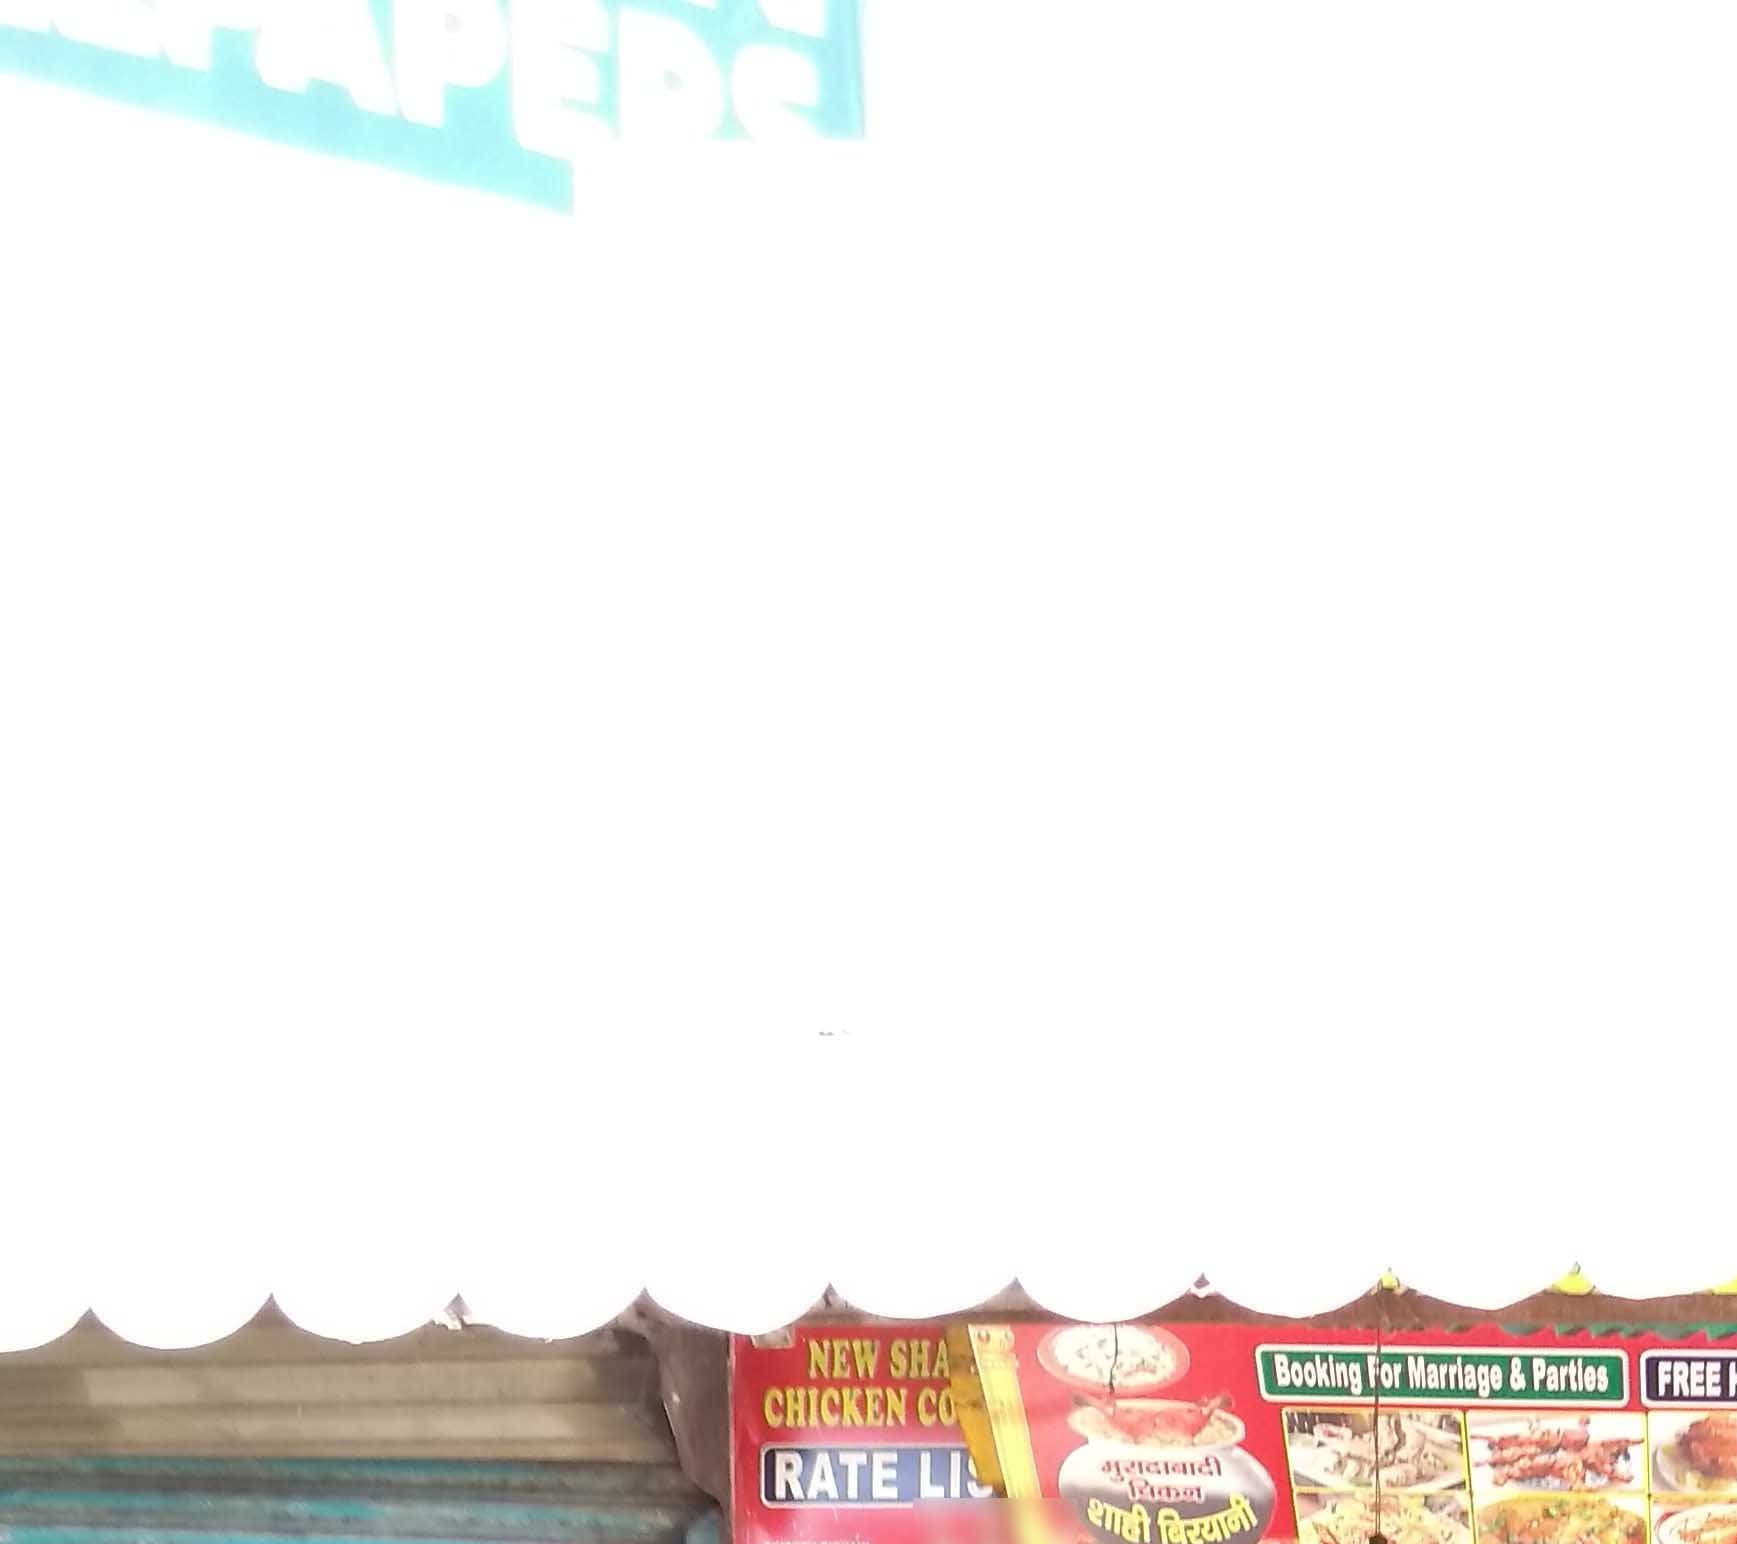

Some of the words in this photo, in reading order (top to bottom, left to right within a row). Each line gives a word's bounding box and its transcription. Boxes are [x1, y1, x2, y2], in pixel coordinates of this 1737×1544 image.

[808, 1339, 881, 1379] NEW
[889, 1338, 951, 1379] SHA
[1273, 1354, 1362, 1396] Booking
[1366, 1355, 1402, 1389] For
[1407, 1356, 1501, 1398] Marriage
[1509, 1357, 1526, 1391] &
[1532, 1357, 1608, 1392] Parties
[1657, 1361, 1721, 1398] FREE
[763, 1387, 908, 1428] CHICKEN
[916, 1388, 958, 1428] CO
[774, 1450, 899, 1500] RATE
[918, 1451, 994, 1499] LIS
[1087, 1497, 1151, 1544] शाही
